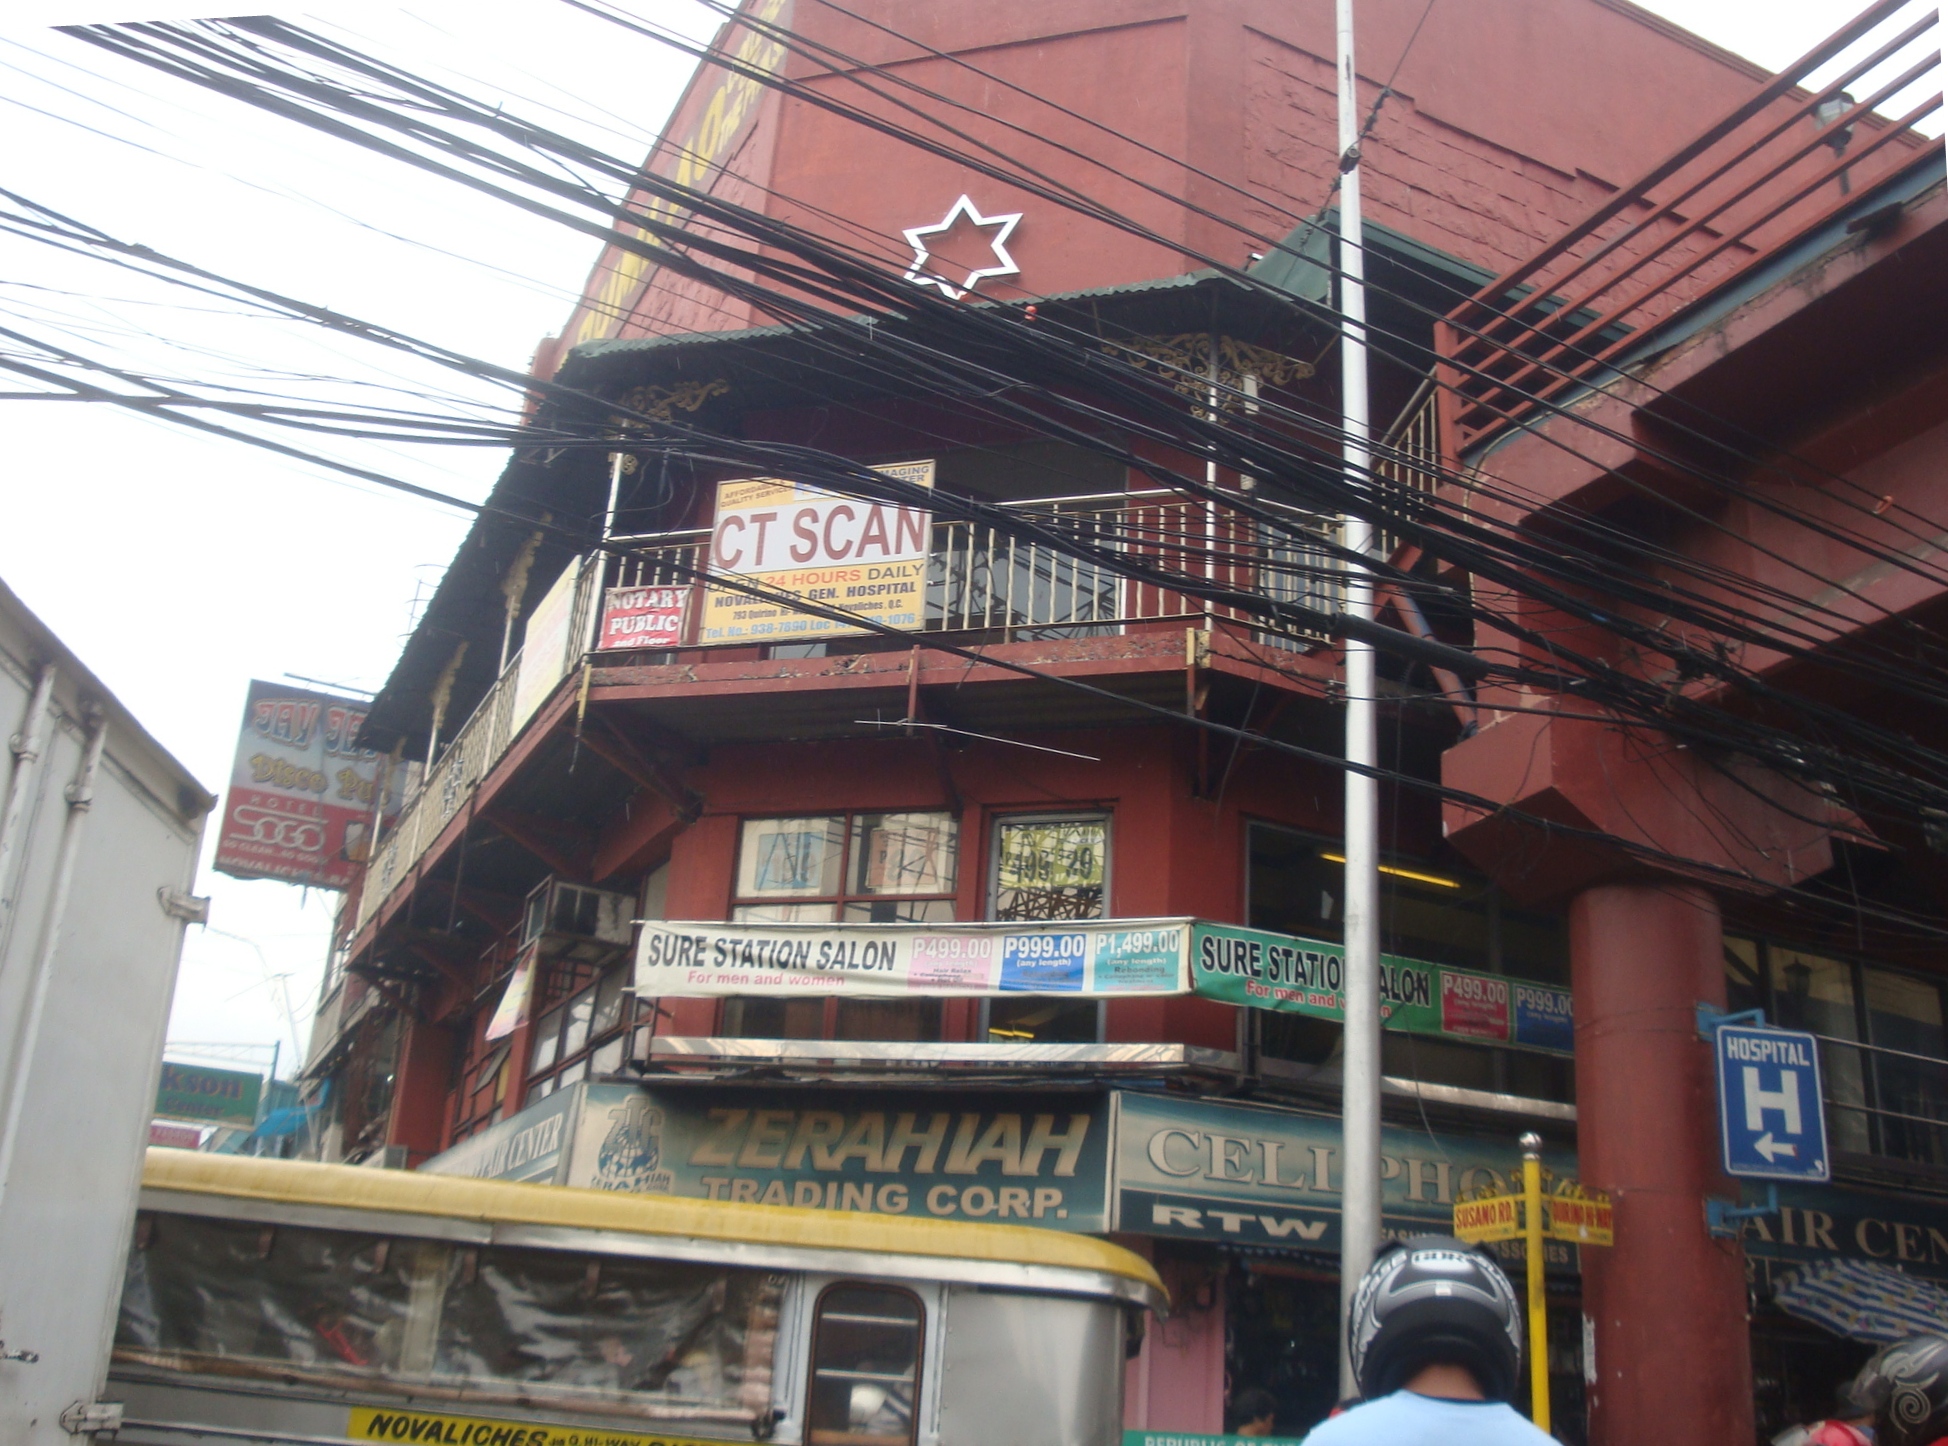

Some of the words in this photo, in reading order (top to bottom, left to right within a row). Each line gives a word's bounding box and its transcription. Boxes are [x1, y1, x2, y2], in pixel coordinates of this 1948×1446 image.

[714, 511, 777, 570] CT
[789, 504, 926, 563] SCAN
[766, 575, 786, 588] 24
[792, 569, 861, 585] HOURS
[867, 563, 925, 580] DAILY
[808, 587, 840, 599] GEN.
[846, 581, 917, 598] HOSPITAL
[607, 588, 689, 610] NOTARY
[608, 614, 679, 635] PUBLIC
[706, 627, 723, 640] Tel.
[810, 618, 831, 630] Loc
[249, 752, 328, 794] Disco
[250, 795, 323, 817] HOTEL
[228, 804, 329, 852] SOGO
[648, 934, 707, 968] SURE
[713, 937, 811, 971] STATION
[816, 940, 897, 972] SALON
[912, 937, 991, 960] P499.00
[1003, 934, 1085, 960] P999.00
[1094, 930, 1180, 959] P1,499.00
[1016, 958, 1037, 968] (any
[1038, 957, 1072, 969] length)
[1114, 965, 1165, 974] Rebonding
[1200, 934, 1263, 977] SURE
[1267, 945, 1346, 993] STATIO
[1380, 962, 1431, 1008] ALON
[687, 970, 712, 984] For
[716, 973, 749, 985] men
[754, 972, 783, 986] and
[788, 974, 845, 987] women
[1443, 974, 1506, 1004] P499.00
[1245, 979, 1270, 999] For
[1274, 987, 1304, 1004] men
[1309, 989, 1335, 1009] and
[1726, 1036, 1811, 1067] HOSPITAL
[1743, 1066, 1802, 1135] H
[507, 1112, 563, 1171] CENTER
[686, 1107, 1092, 1177] ZERAHIAH
[702, 1177, 910, 1213] TRADING
[926, 1184, 1069, 1219] CORP.
[1152, 1204, 1328, 1240] RTW
[1455, 1202, 1497, 1230] SUSANO
[366, 1413, 548, 1446] NOVALICHES
